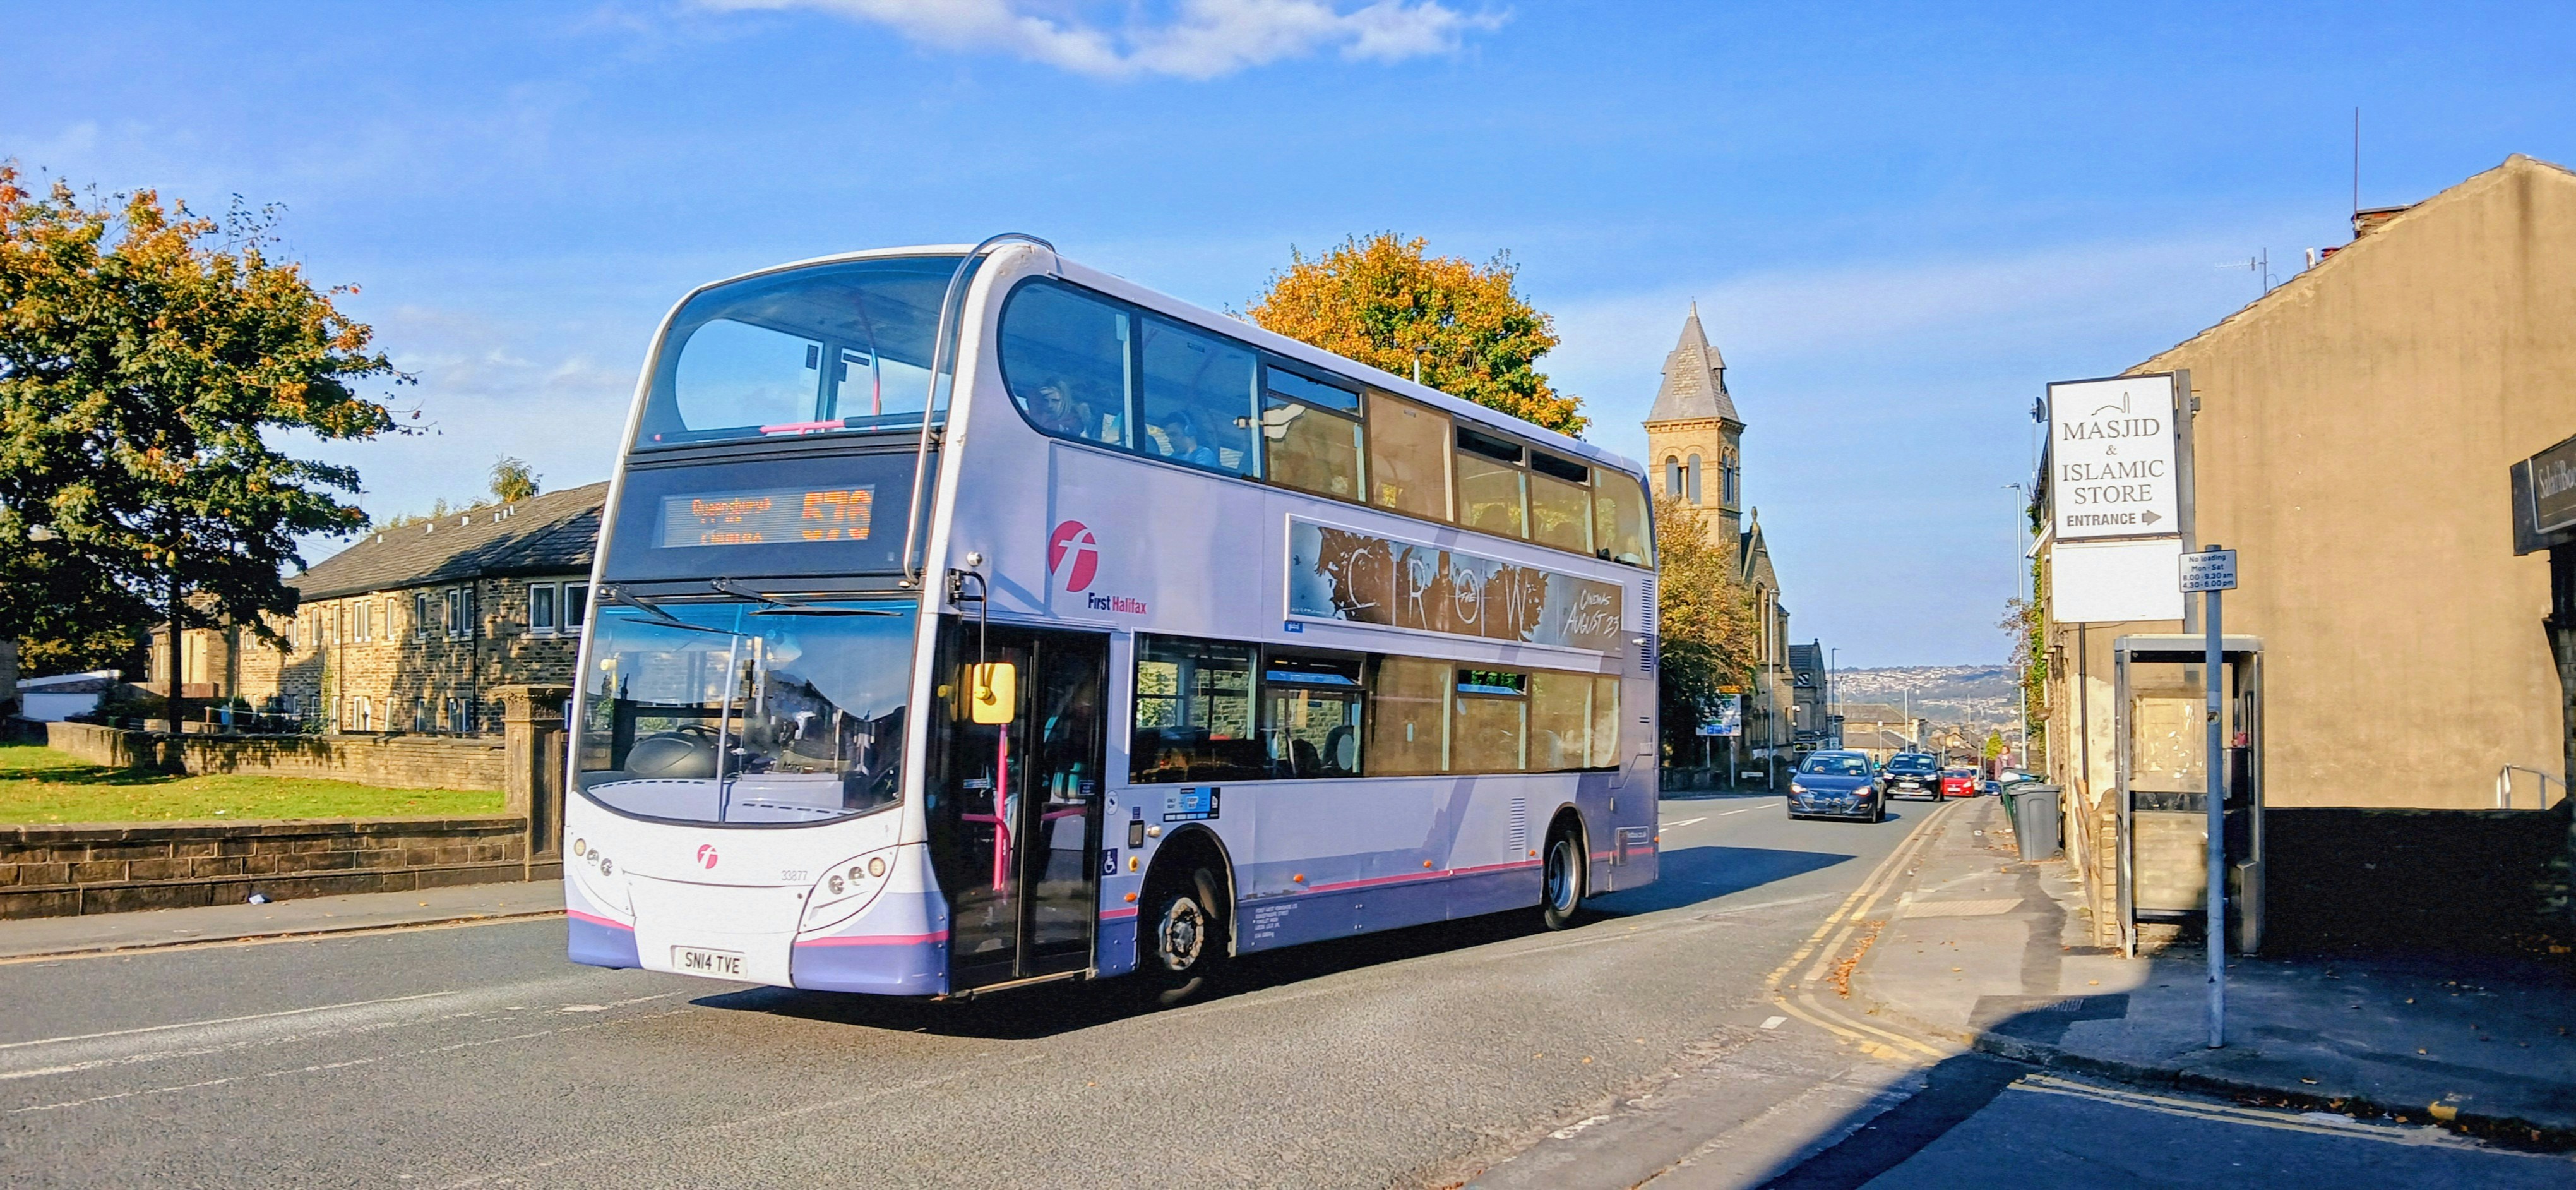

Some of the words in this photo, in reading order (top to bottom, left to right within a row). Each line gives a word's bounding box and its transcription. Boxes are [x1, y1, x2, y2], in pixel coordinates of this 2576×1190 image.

[2063, 418, 2160, 440] MASJID
[2106, 445, 2117, 455] &
[2062, 460, 2164, 481] ISLAMIC
[2074, 484, 2153, 504] STORE
[802, 489, 872, 540] 576
[2066, 513, 2136, 527] ENTRANCE
[1344, 546, 1528, 634] CROW
[1088, 592, 1111, 611] First
[1112, 596, 1147, 615] Halifax
[1604, 615, 1621, 638] 23
[782, 870, 808, 881] 33877
[685, 951, 712, 970] SN14
[717, 955, 740, 974] TVE
